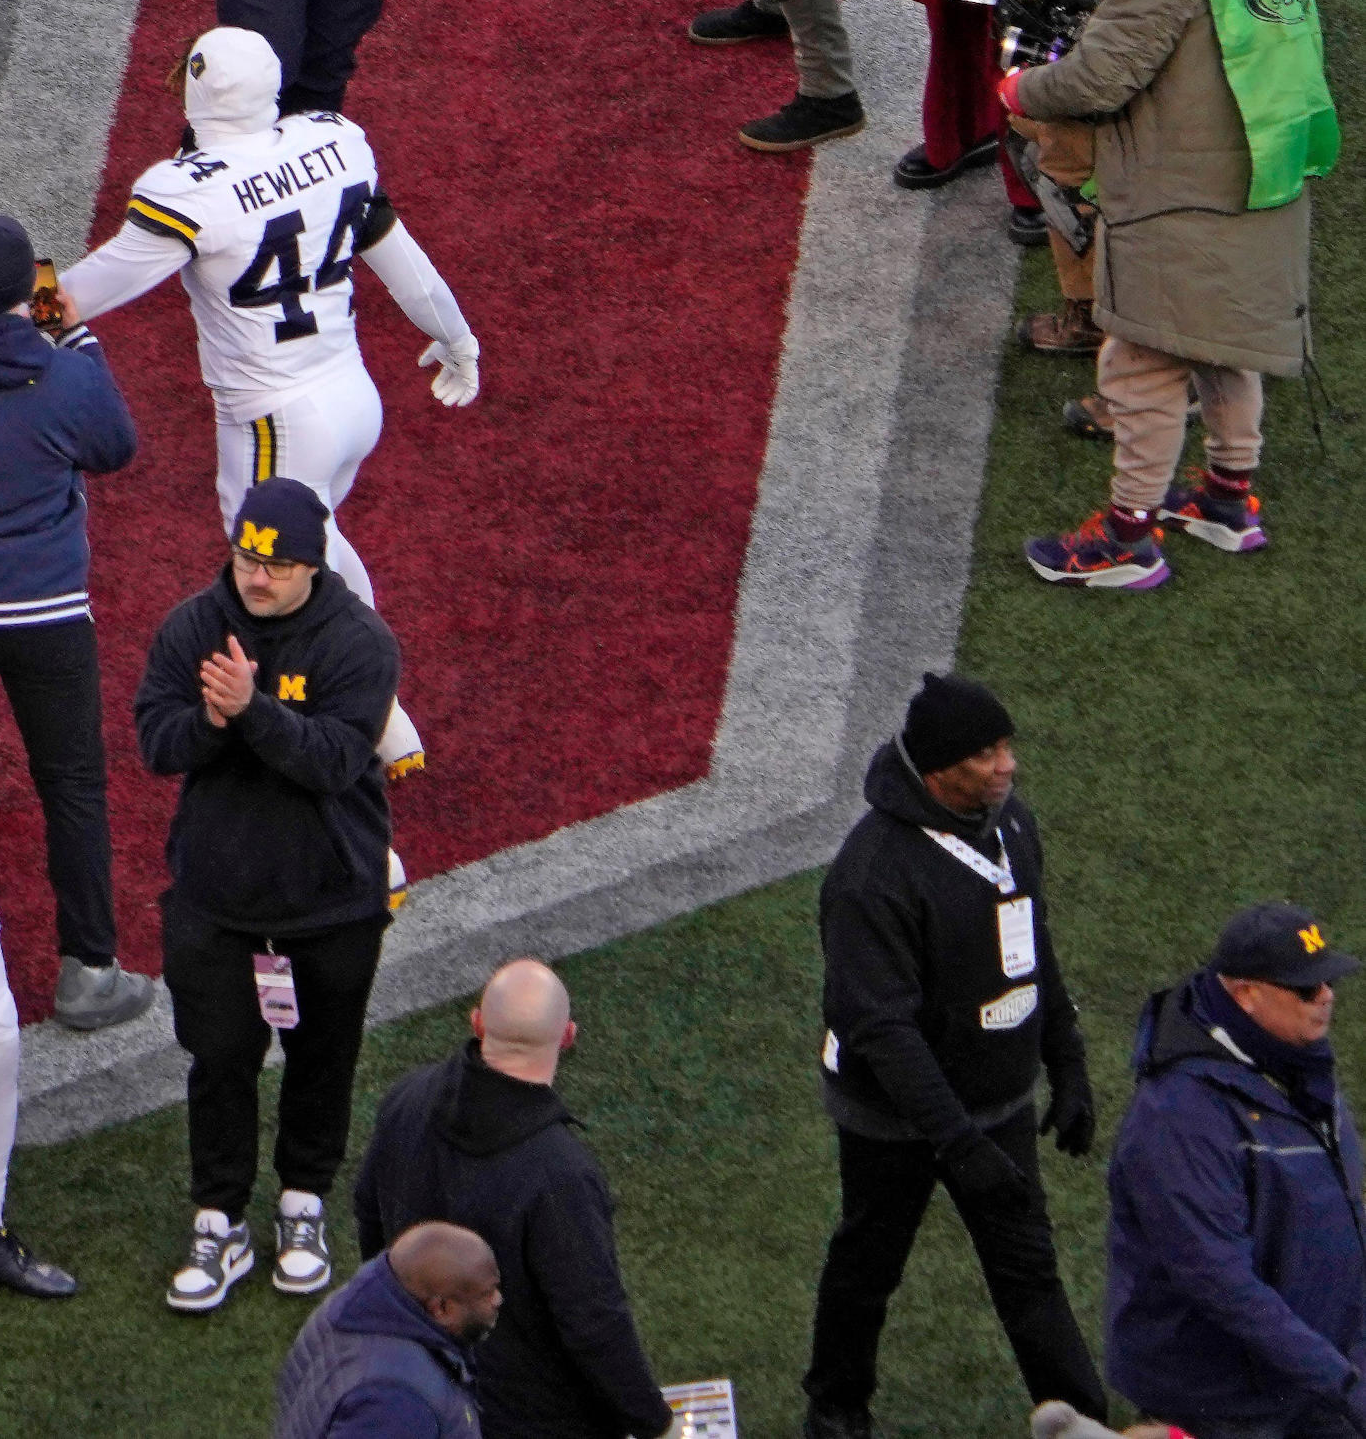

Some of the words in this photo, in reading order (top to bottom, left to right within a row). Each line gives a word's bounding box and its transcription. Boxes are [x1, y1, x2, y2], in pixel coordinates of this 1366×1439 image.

[232, 140, 347, 215] HEWLETT
[239, 520, 280, 557] M
[278, 673, 307, 702] M
